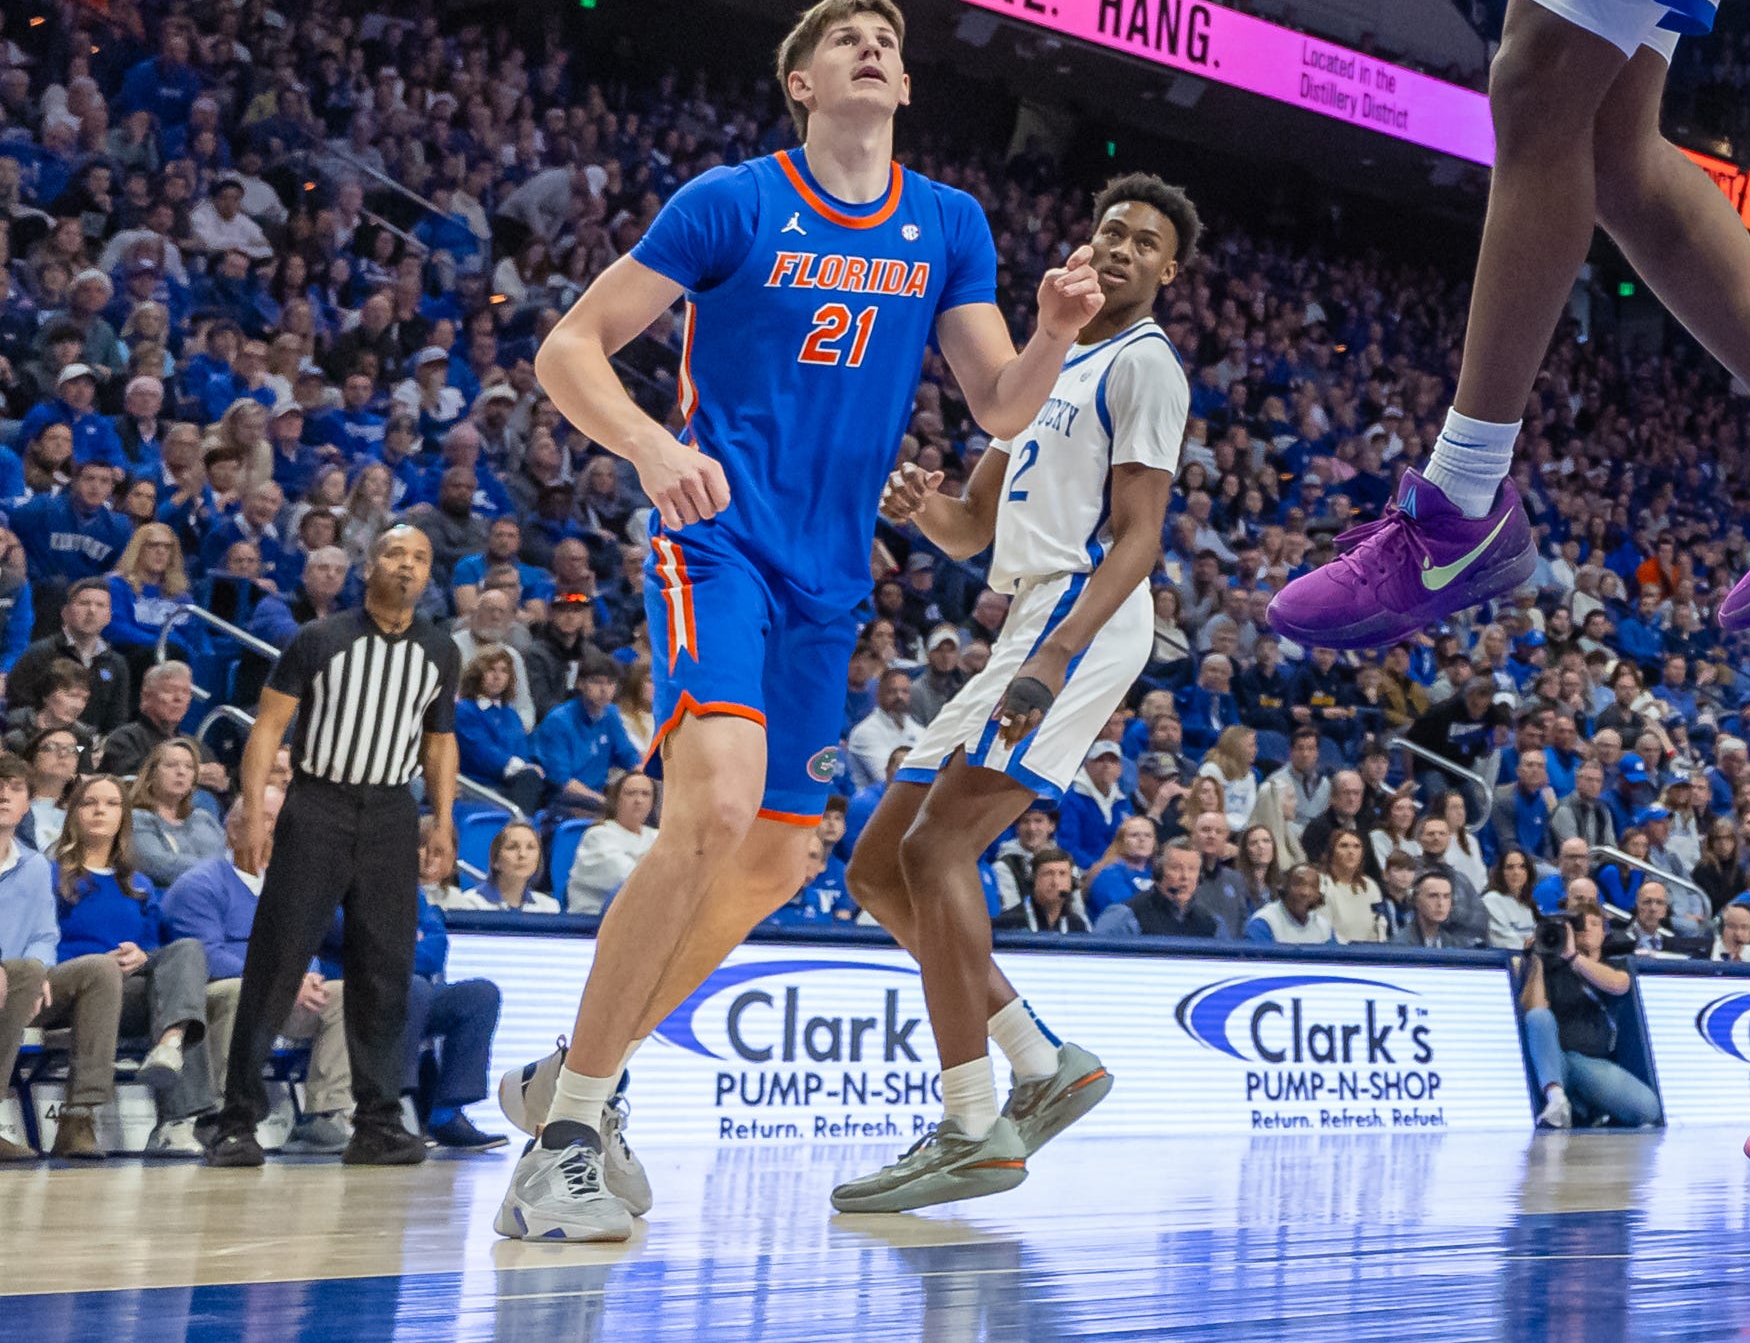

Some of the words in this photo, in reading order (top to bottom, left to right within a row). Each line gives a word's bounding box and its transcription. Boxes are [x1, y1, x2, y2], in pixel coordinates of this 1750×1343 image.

[1301, 39, 1355, 82] Located
[1360, 55, 1372, 85] in
[1375, 60, 1397, 94] the
[1300, 72, 1358, 118] Distillery
[1362, 90, 1409, 131] District
[764, 251, 931, 298] FLORIDA
[797, 302, 879, 368] 21
[1008, 439, 1040, 502] 2
[1250, 997, 1433, 1064] Clark's
[1246, 1070, 1441, 1101] PUMP-N-SHOP
[719, 1117, 803, 1140] Return.
[813, 1114, 903, 1138] Refresh.
[1251, 1110, 1313, 1129] Return.
[1320, 1108, 1386, 1128] Refresh.
[1392, 1107, 1447, 1127] Refuel.
